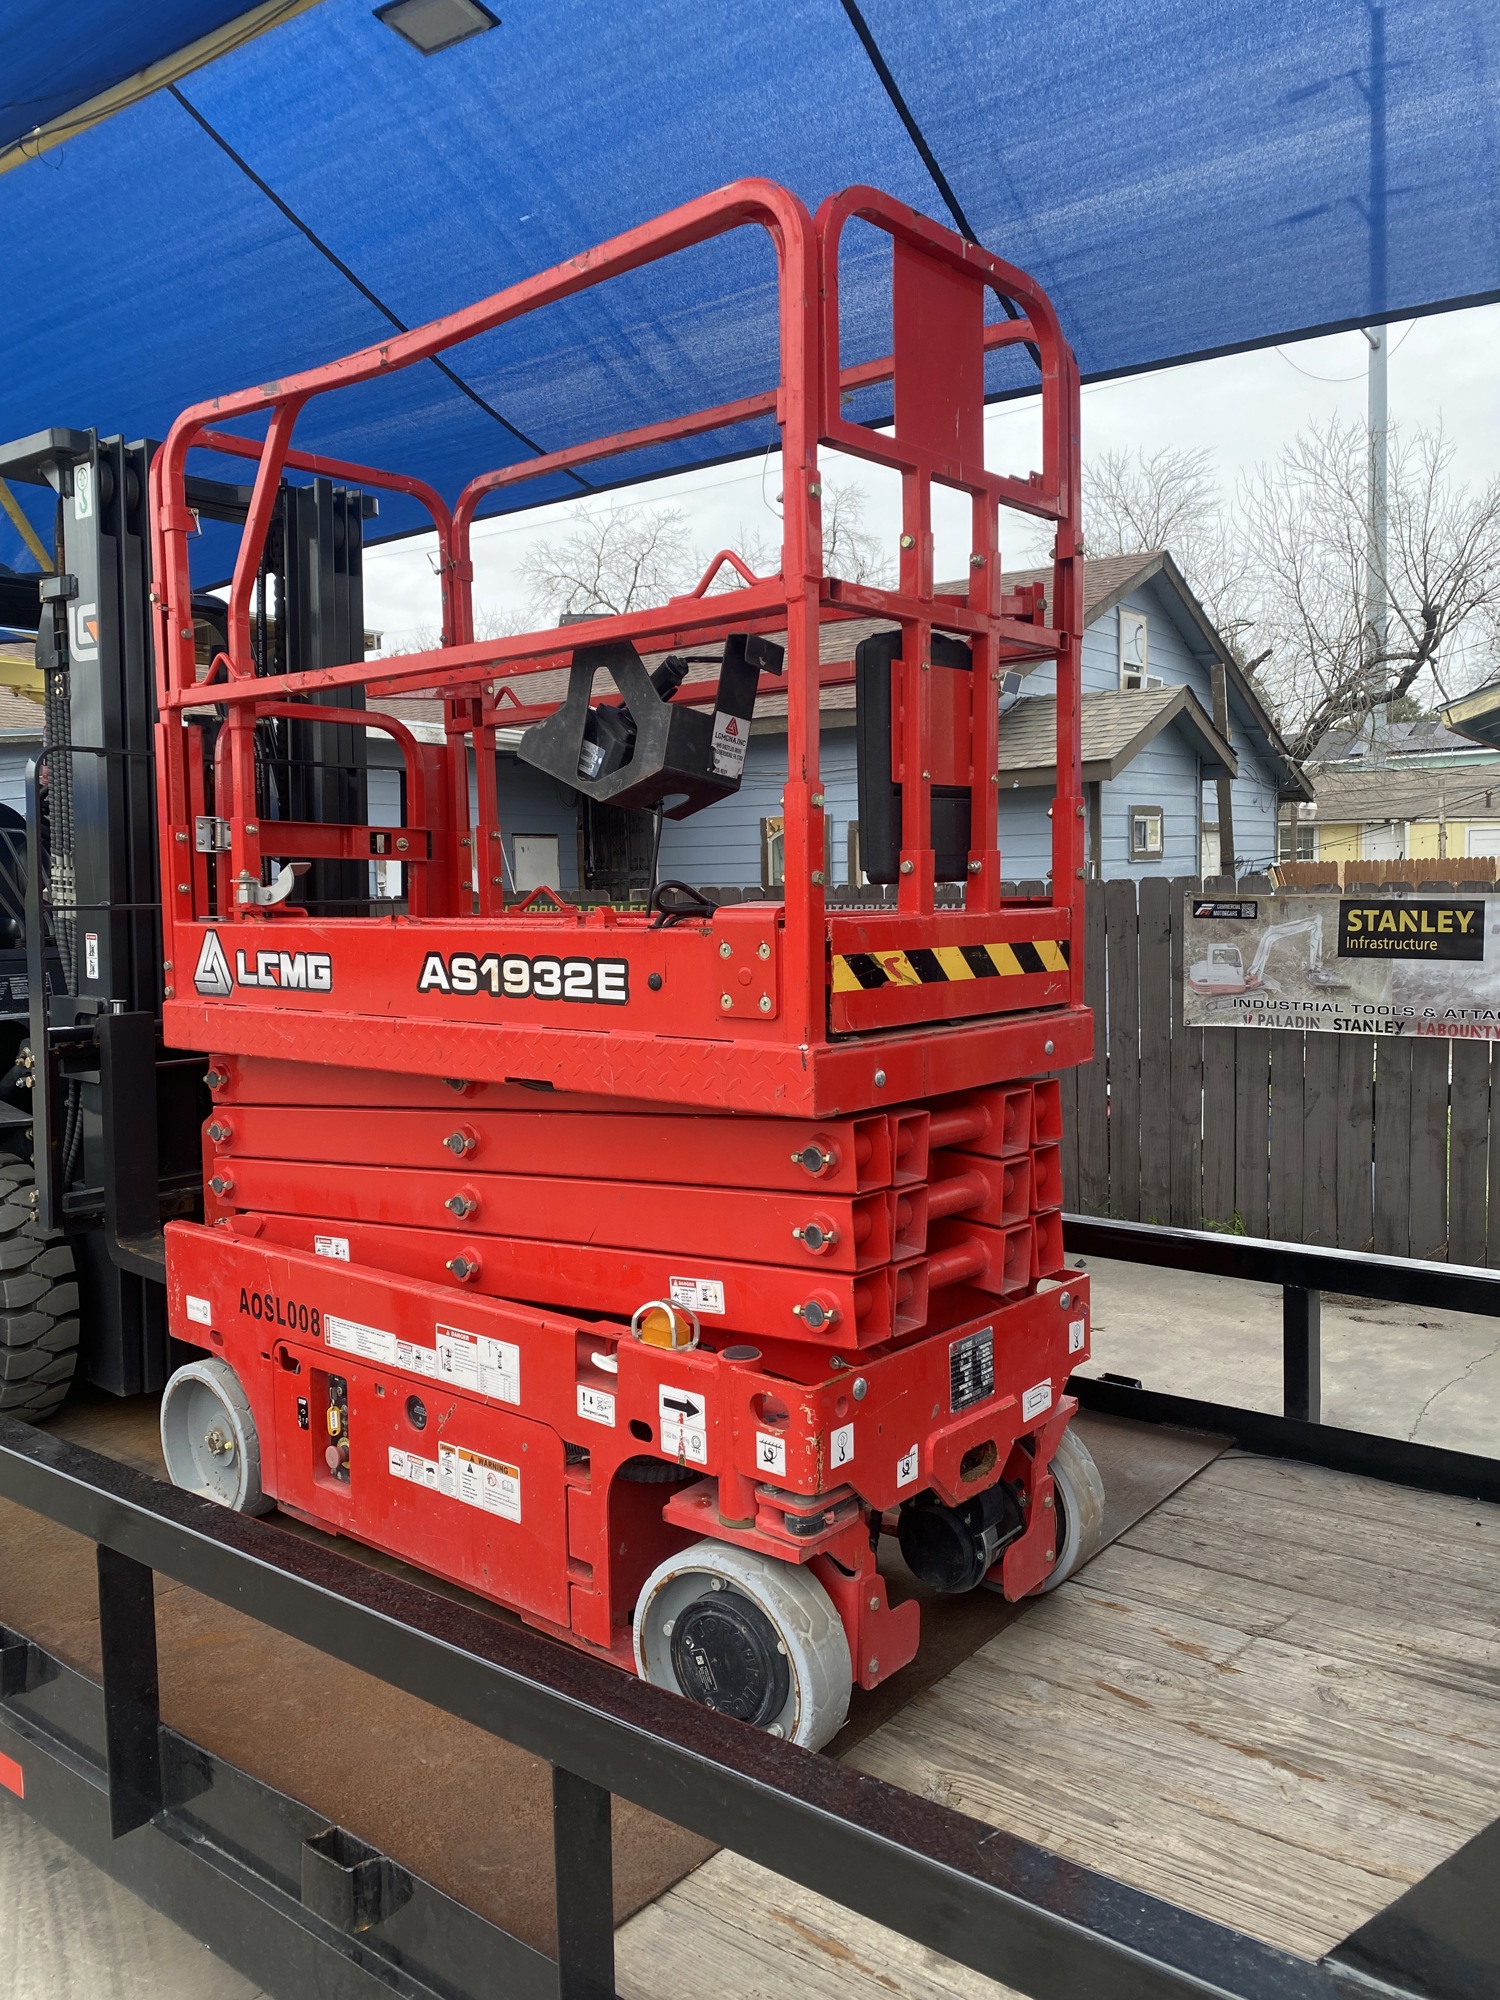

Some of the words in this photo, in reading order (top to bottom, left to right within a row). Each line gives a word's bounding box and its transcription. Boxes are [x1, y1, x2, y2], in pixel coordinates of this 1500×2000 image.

[1347, 909, 1475, 934] STANLEY
[1346, 935, 1438, 951] Infrastructure
[418, 954, 627, 1000] AS1932E
[1233, 998, 1344, 1013] INDUSTRIAL
[1351, 1003, 1415, 1018] TOOLS
[1423, 1007, 1437, 1018] &
[1444, 1008, 1500, 1020] ATTA
[1257, 1013, 1321, 1029] PALADIN
[1333, 1017, 1405, 1035] STANLEY
[450, 1330, 470, 1341] DANGER
[477, 1457, 509, 1475] WARNING
